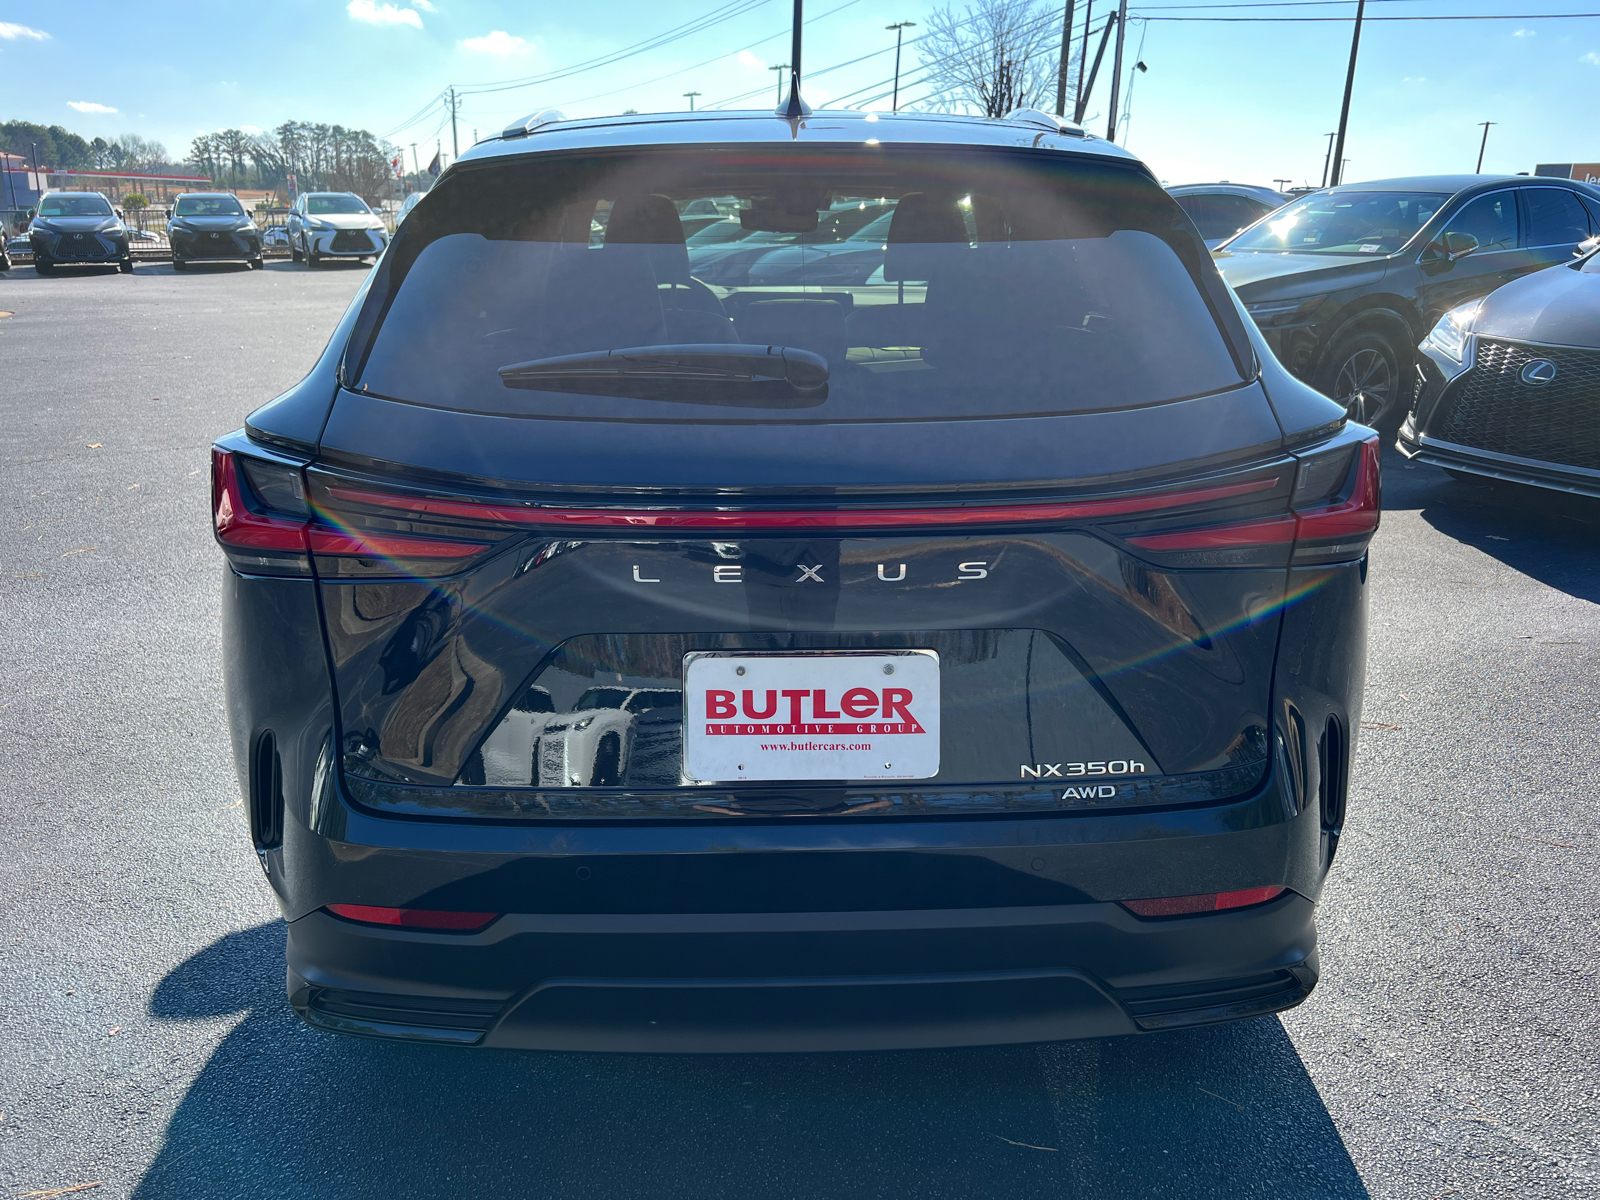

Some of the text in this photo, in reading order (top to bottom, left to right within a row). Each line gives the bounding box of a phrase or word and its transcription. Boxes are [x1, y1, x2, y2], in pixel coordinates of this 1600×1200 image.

[632, 561, 988, 583] LEXUS
[707, 723, 918, 734] AUTOMOTIVE GROUP
[760, 741, 871, 751] www.butlercars.com
[1061, 785, 1116, 800] AWD
